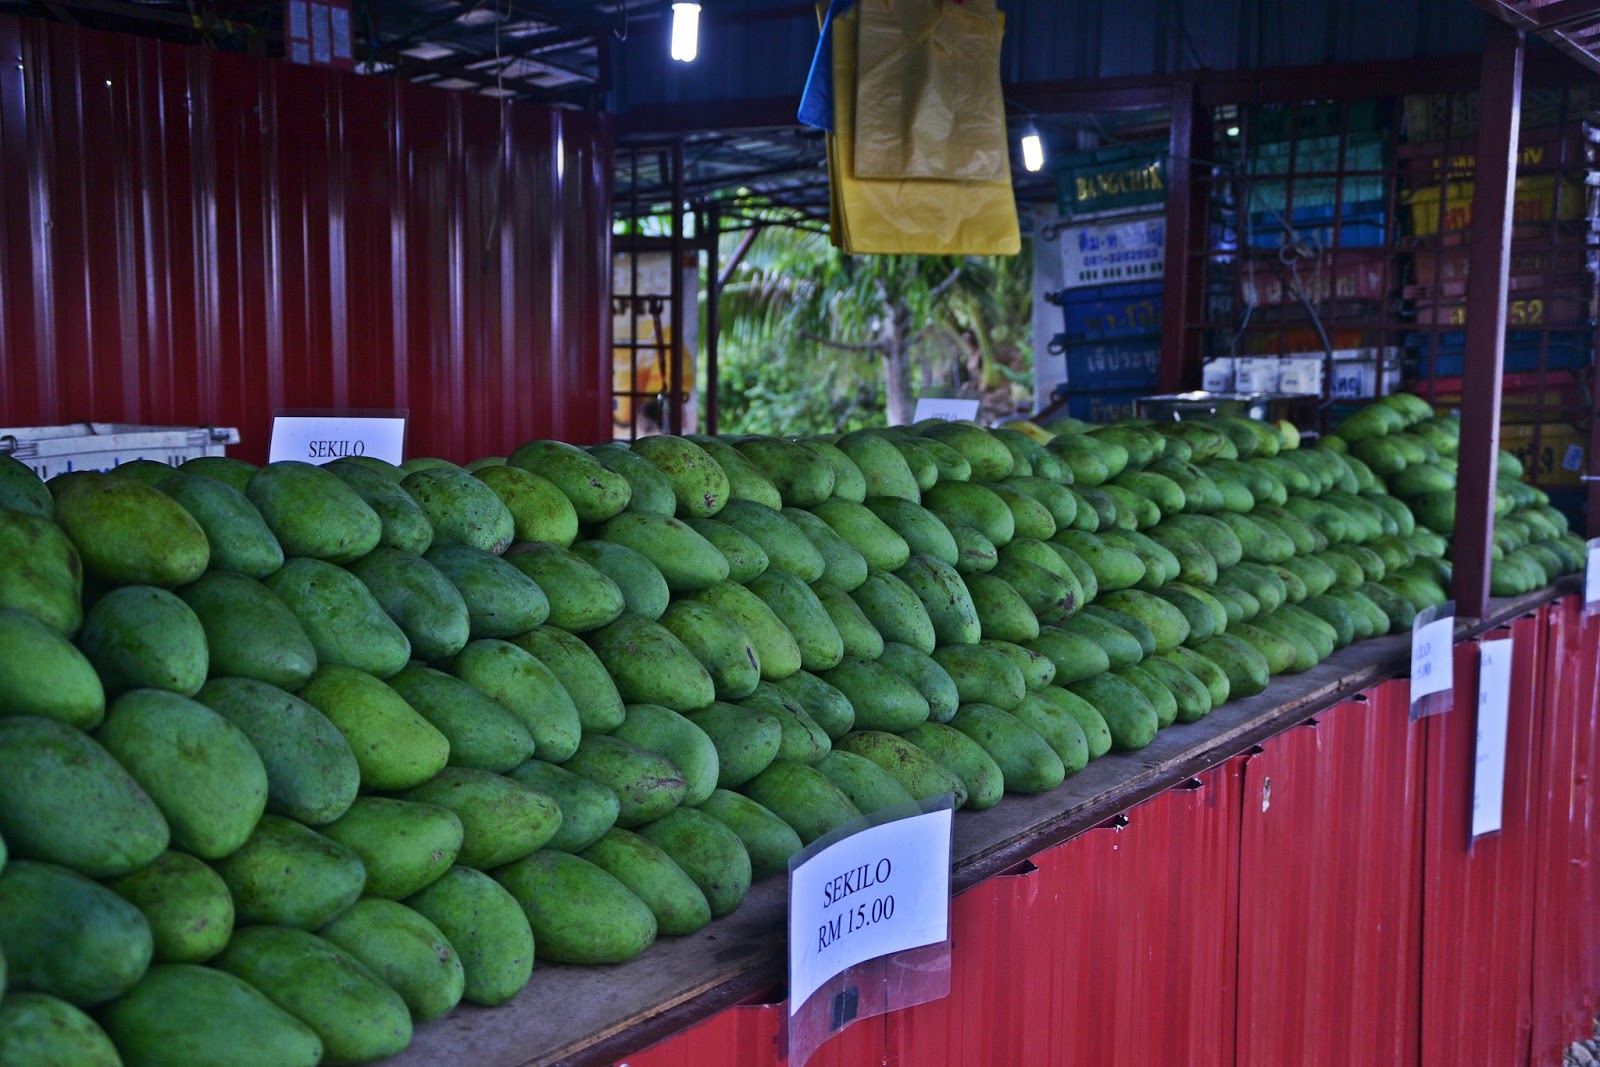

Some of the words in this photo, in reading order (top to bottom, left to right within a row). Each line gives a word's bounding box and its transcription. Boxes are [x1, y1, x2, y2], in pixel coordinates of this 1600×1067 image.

[308, 440, 365, 457] SEKILO
[822, 857, 892, 909] SEKILO
[817, 913, 844, 954] RM
[846, 894, 895, 934] 15.00
